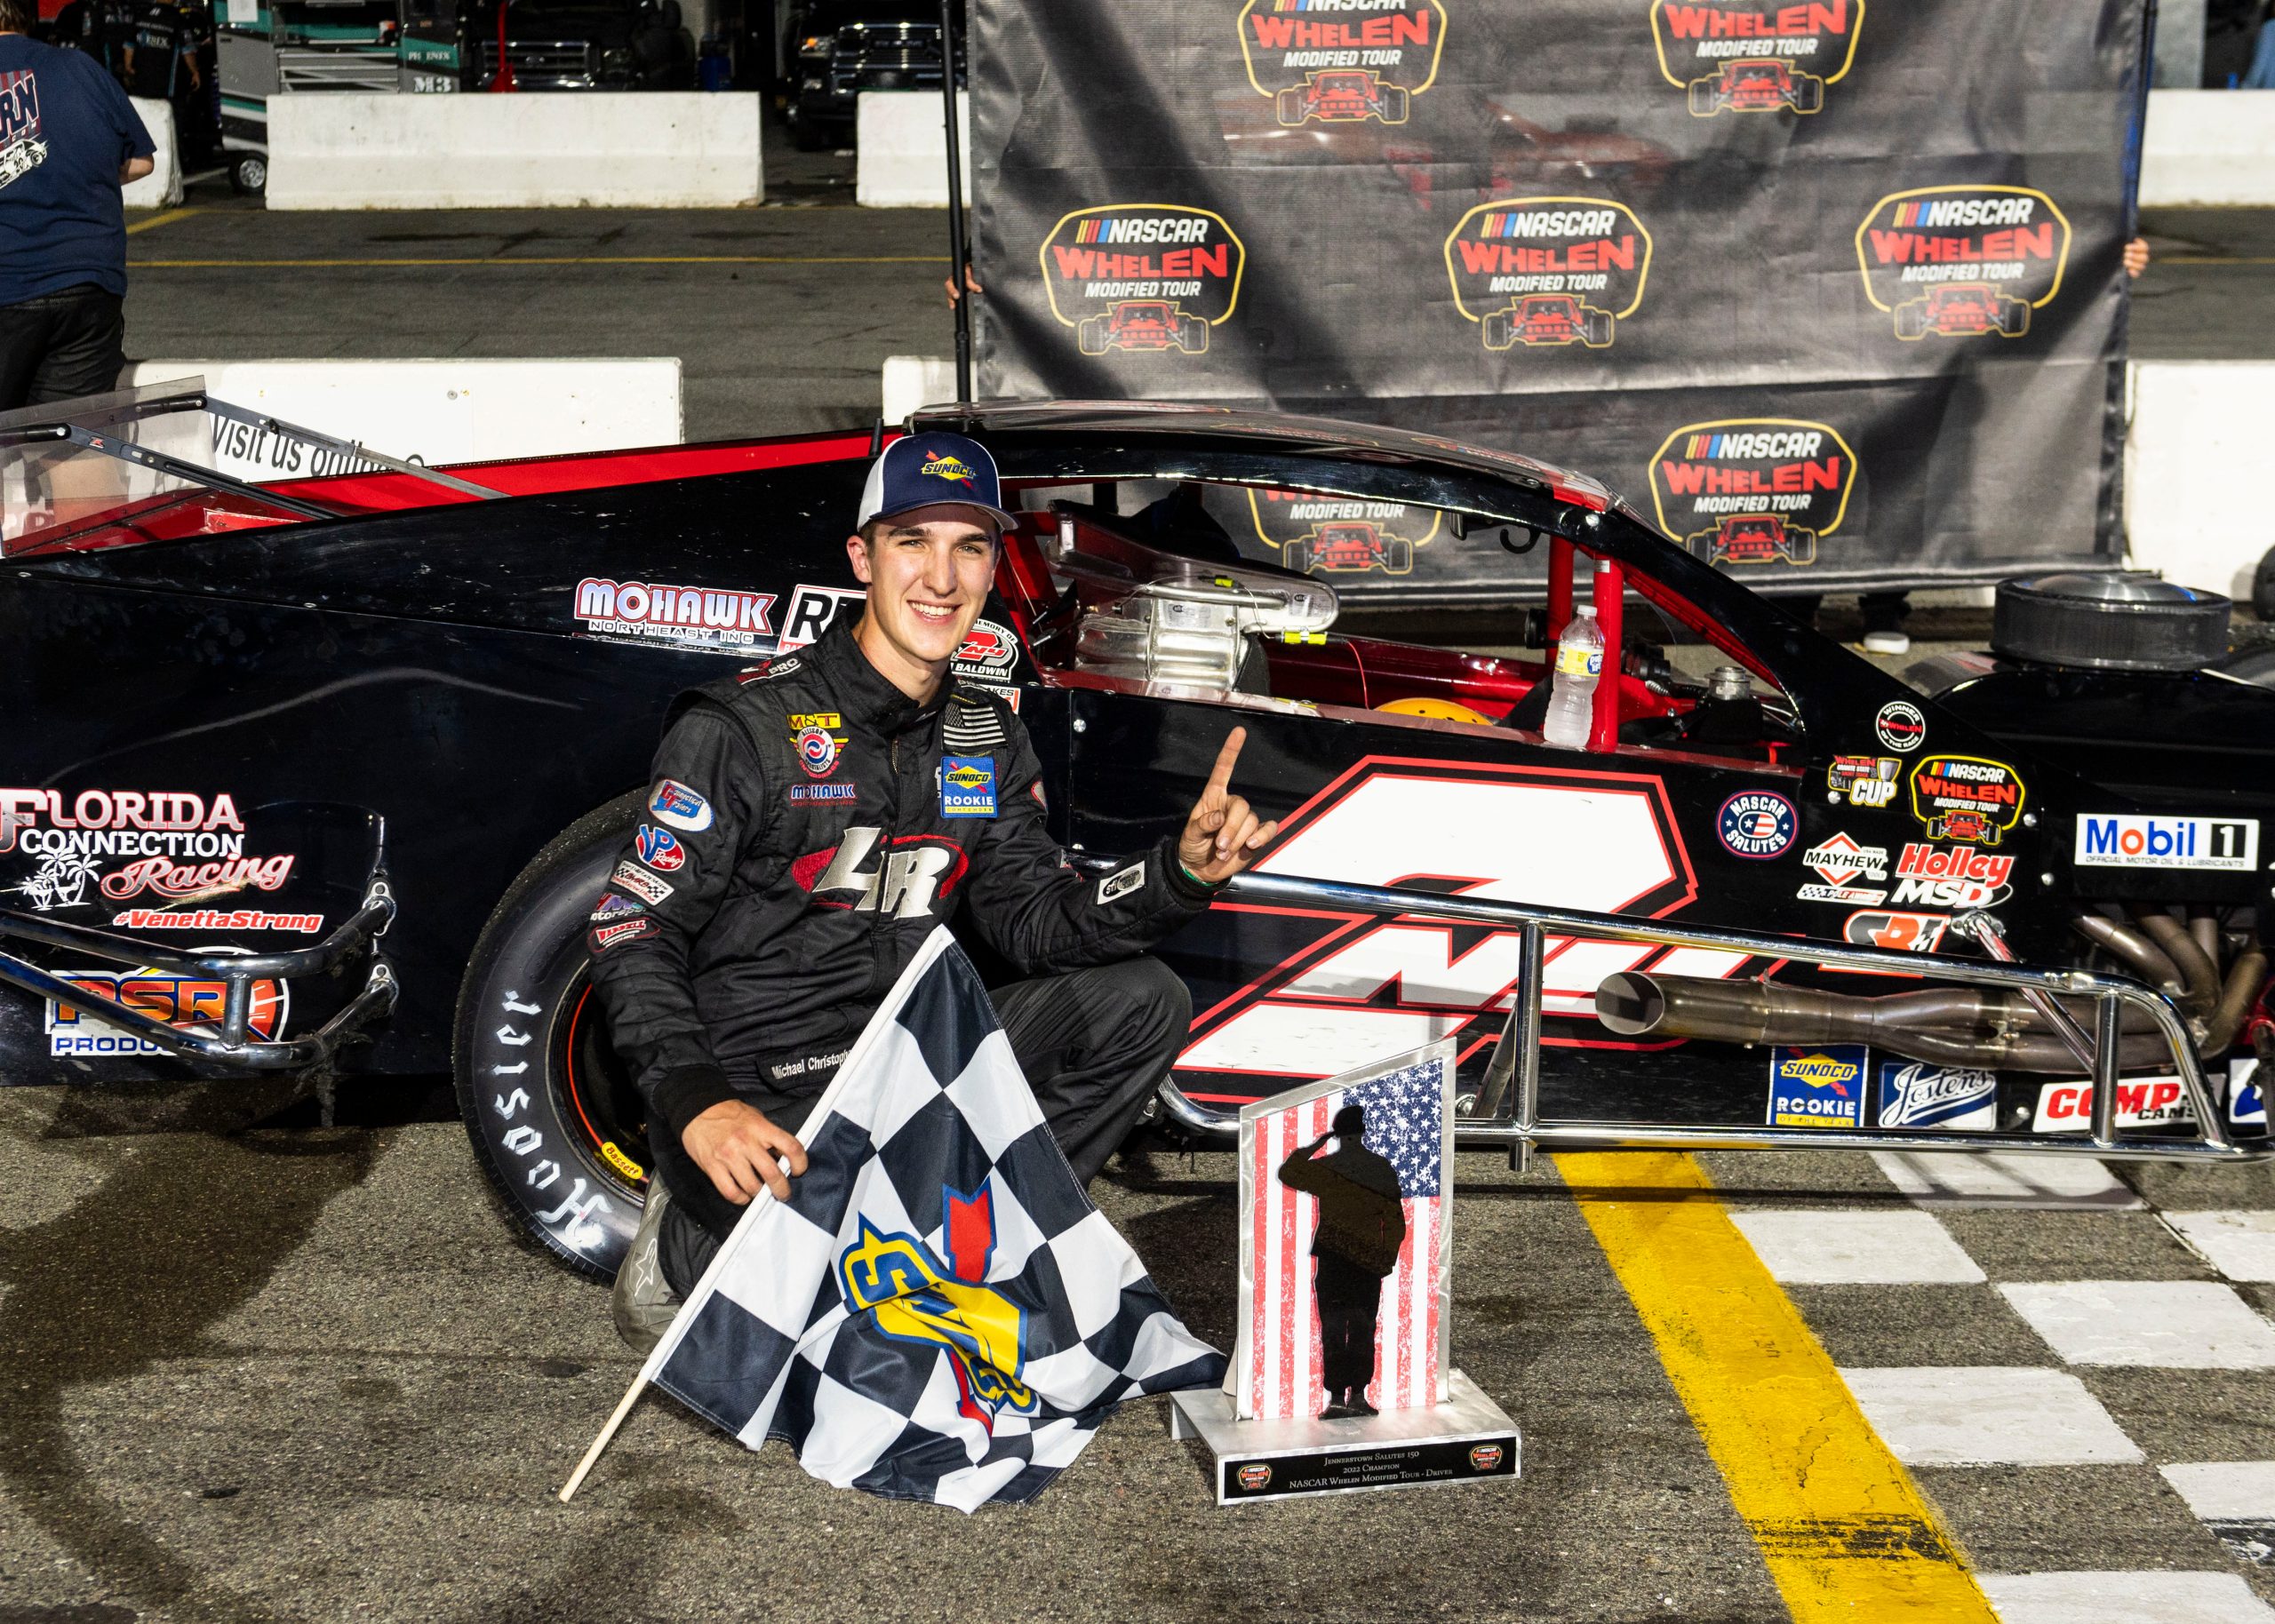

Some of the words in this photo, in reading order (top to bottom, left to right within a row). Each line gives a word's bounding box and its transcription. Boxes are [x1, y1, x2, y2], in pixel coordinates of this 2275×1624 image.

[1250, 9, 1429, 49] WHELEN
[1664, 0, 1847, 39] WHELEN
[409, 51, 451, 62] PHENIX
[1283, 50, 1359, 68] MODIFIED
[1361, 50, 1402, 66] TOUR
[1696, 40, 1775, 58] MODIFIED
[1776, 38, 1818, 55] TOUR
[1513, 210, 1616, 238] NASCAR
[1926, 197, 2034, 227] NASCAR
[1108, 219, 1209, 243] NASCAR
[1457, 235, 1634, 275] WHELEN
[1869, 222, 2053, 265] WHELEN
[1052, 243, 1227, 279] WHELEN
[1901, 265, 1980, 283] MODIFIED
[1981, 262, 2025, 280] TOUR
[1084, 282, 1160, 298] MODIFIED
[1161, 281, 1201, 297] TOUR
[1489, 275, 1566, 292] MODIFIED
[1567, 274, 1608, 291] TOUR
[271, 434, 303, 472] us
[1718, 432, 1822, 458] NASCAR
[924, 463, 977, 479] SUNOCO
[1662, 456, 1840, 495] WHELEN
[1289, 503, 1362, 519] MODIFIED
[1365, 502, 1406, 518] TOUR
[1694, 495, 1768, 513] MODIFIED
[1771, 494, 1811, 511] TOUR
[576, 579, 776, 633] MOHAWK
[588, 619, 712, 640] NORTHEAST
[720, 631, 755, 645] INC
[955, 663, 1009, 677] BALDWIN
[1883, 705, 1920, 721] WINNER
[1834, 755, 1876, 767] WHELEN
[1948, 762, 2006, 784] NASCAR
[947, 773, 990, 783] SUNOCO
[1918, 774, 2016, 804] WHELEN
[791, 784, 856, 800] MOHAWK
[944, 796, 994, 806] ROOKIE
[1851, 779, 1896, 805] CUP
[1729, 796, 1787, 820] NASCAR
[1934, 797, 1976, 810] MODIFIED
[1976, 801, 2000, 813] TOUR
[0, 788, 245, 853] FLORIDA
[20, 829, 245, 856] CONNECTION
[639, 824, 676, 864] VP
[1725, 829, 1787, 853] SALUTES
[2086, 818, 2196, 856] Mobil
[653, 852, 683, 869] Racing
[1805, 851, 1882, 869] MAYHEW
[1896, 843, 2015, 889] Holley
[2126, 856, 2153, 865] MOTOR
[2187, 858, 2245, 868] LUBRICANTS
[101, 854, 294, 900] Racing
[812, 826, 950, 920] LR
[1890, 879, 1993, 908] MSD
[113, 909, 323, 933] #VenettaStrong
[1173, 772, 1679, 1079] 2
[771, 1060, 805, 1079] Michael
[808, 1049, 852, 1071] Christoph
[1784, 1063, 1855, 1079] SUNOCO
[1777, 1097, 1856, 1116] ROOKIE
[1881, 1063, 1992, 1126] Jostens
[492, 990, 613, 1235] Hoosier
[605, 1145, 640, 1176] Bassett
[1324, 1455, 1373, 1466] JENNERSTOWN
[1362, 1463, 1400, 1472] CHAMPION
[1289, 1478, 1328, 1489] NASCAR
[1329, 1477, 1361, 1485] WHELEN
[1361, 1473, 1398, 1482] MODIFIED
[1400, 1470, 1420, 1479] TOUR
[1425, 1469, 1453, 1477] DRIVER
